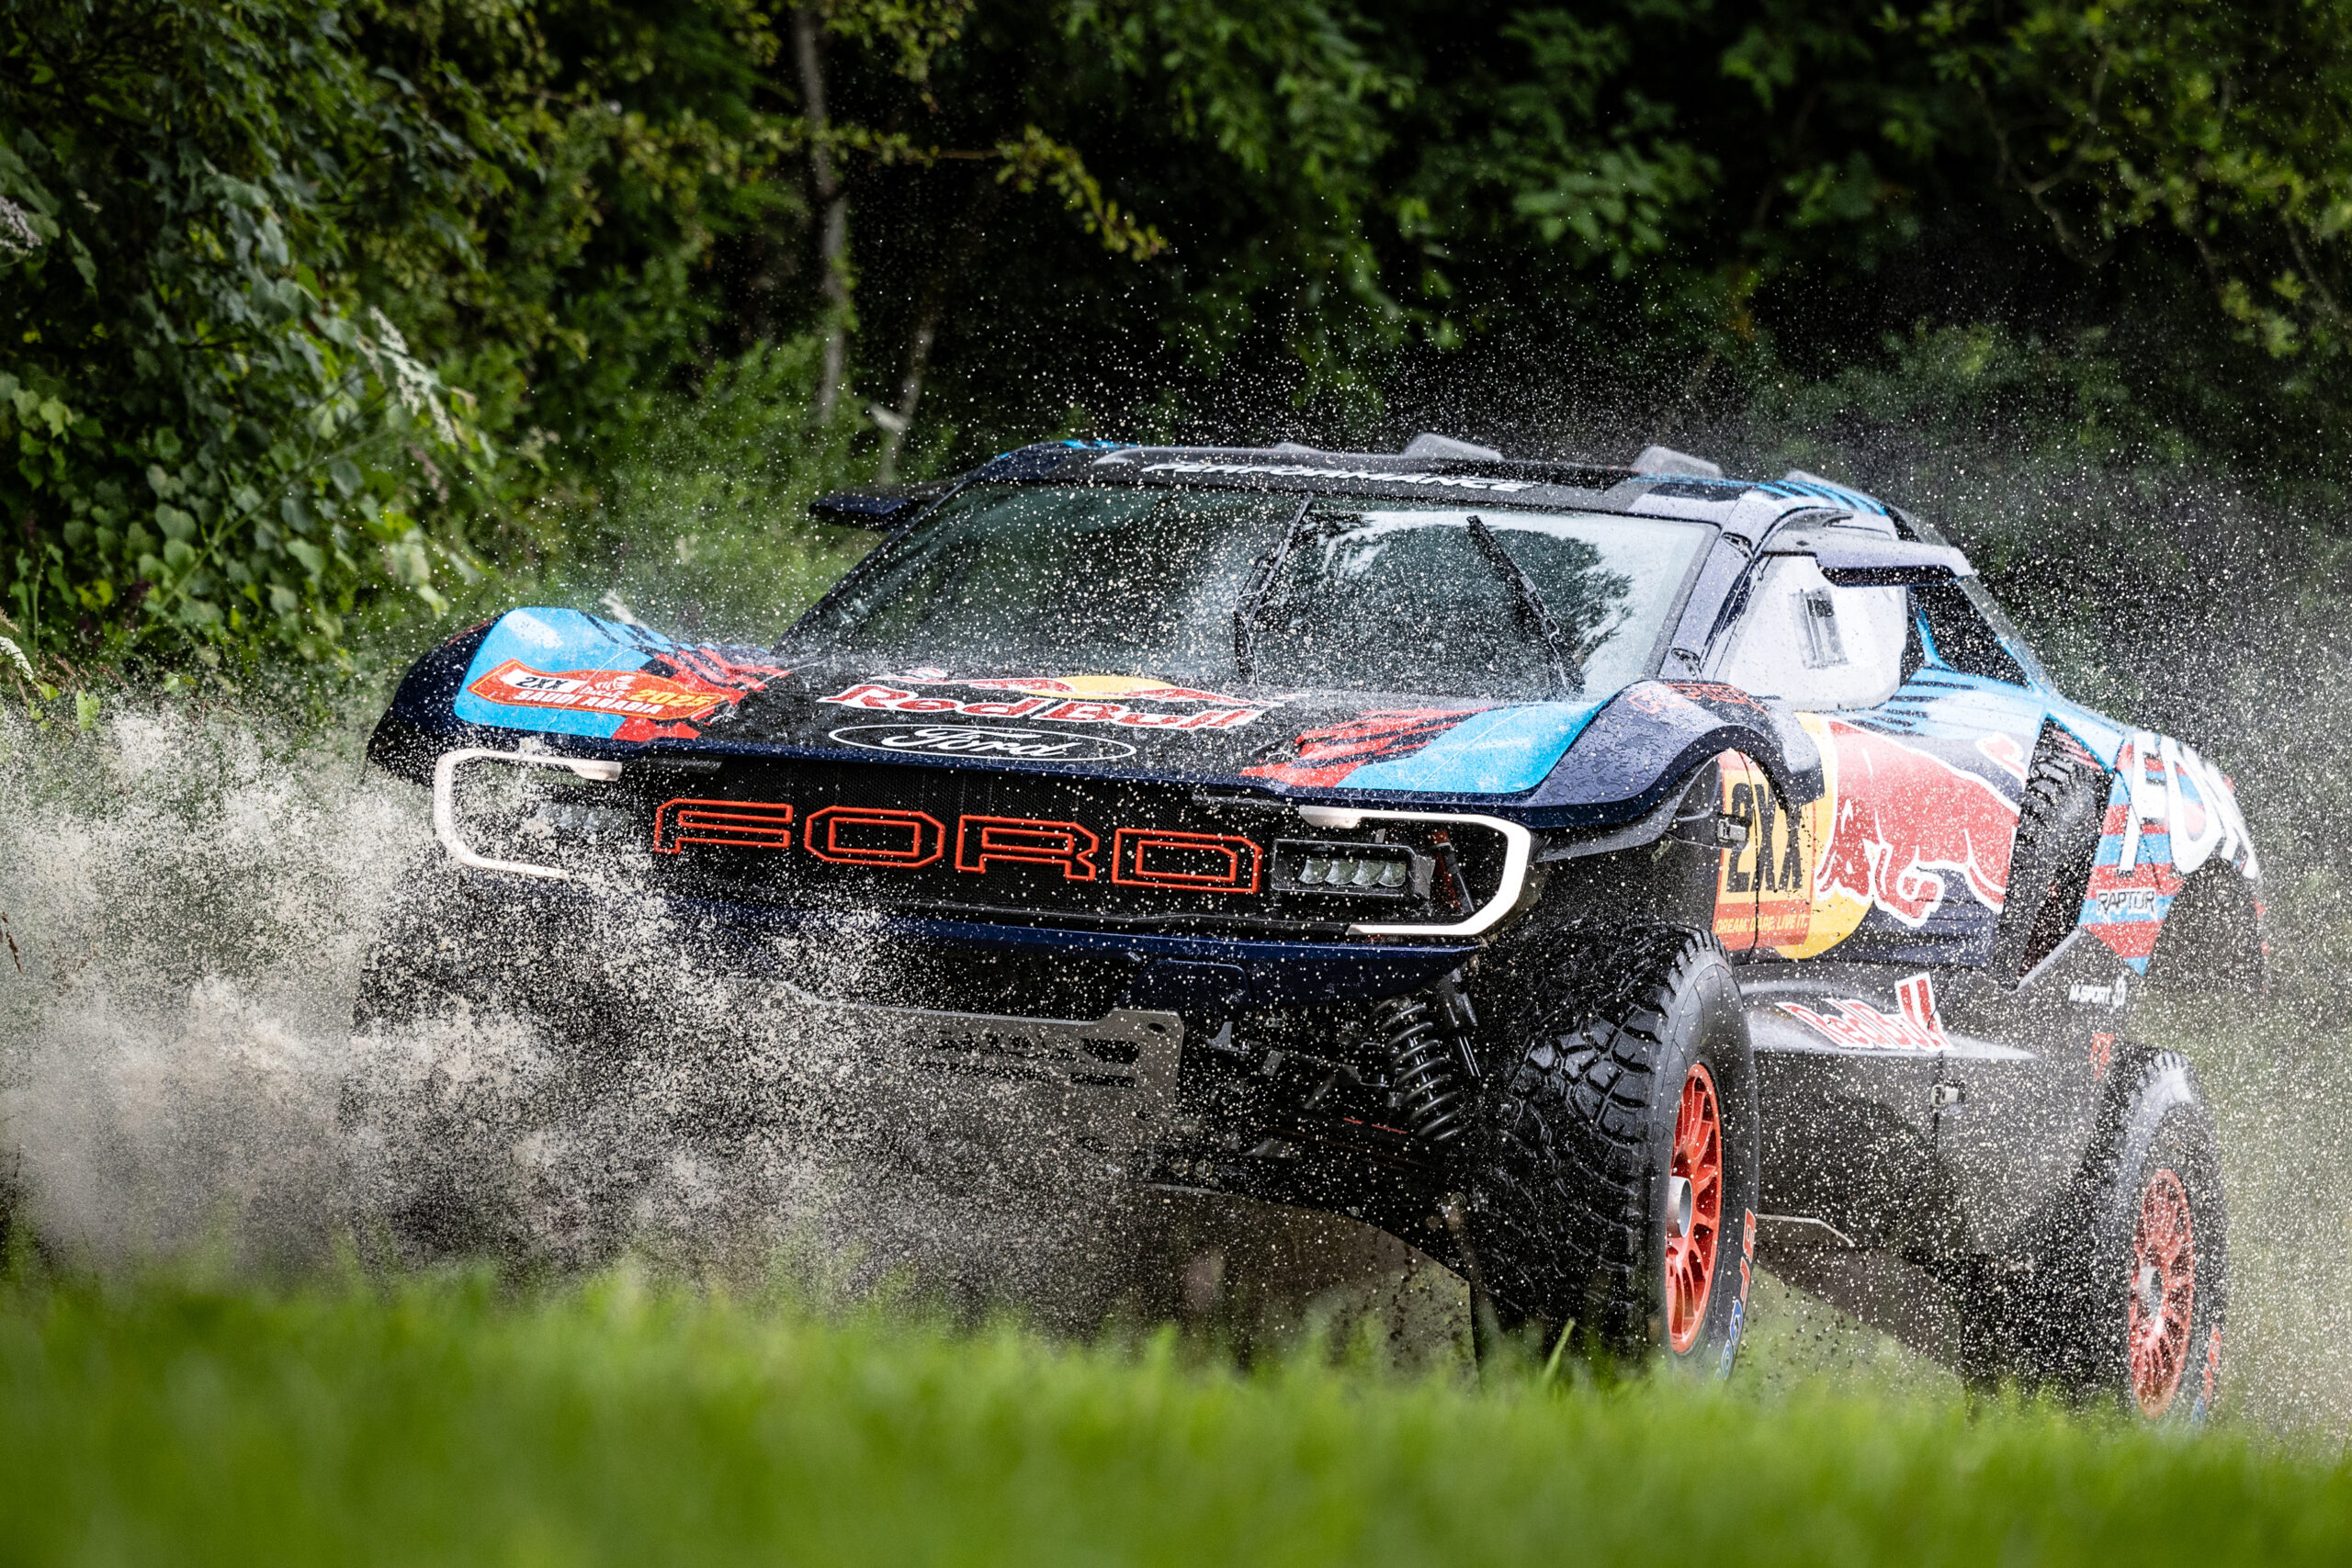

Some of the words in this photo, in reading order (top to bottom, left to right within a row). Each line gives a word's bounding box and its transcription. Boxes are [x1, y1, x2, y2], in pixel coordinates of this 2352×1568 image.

[516, 676, 568, 691] 2XX
[628, 689, 715, 707] 2025
[514, 690, 583, 705] SAUDI
[579, 696, 664, 715] ARABIA
[880, 724, 1082, 758] Ford
[2118, 731, 2261, 879] FOR
[653, 796, 1263, 895] FORD
[1726, 783, 1804, 893] 2XX
[2097, 888, 2156, 913] RAPTOR
